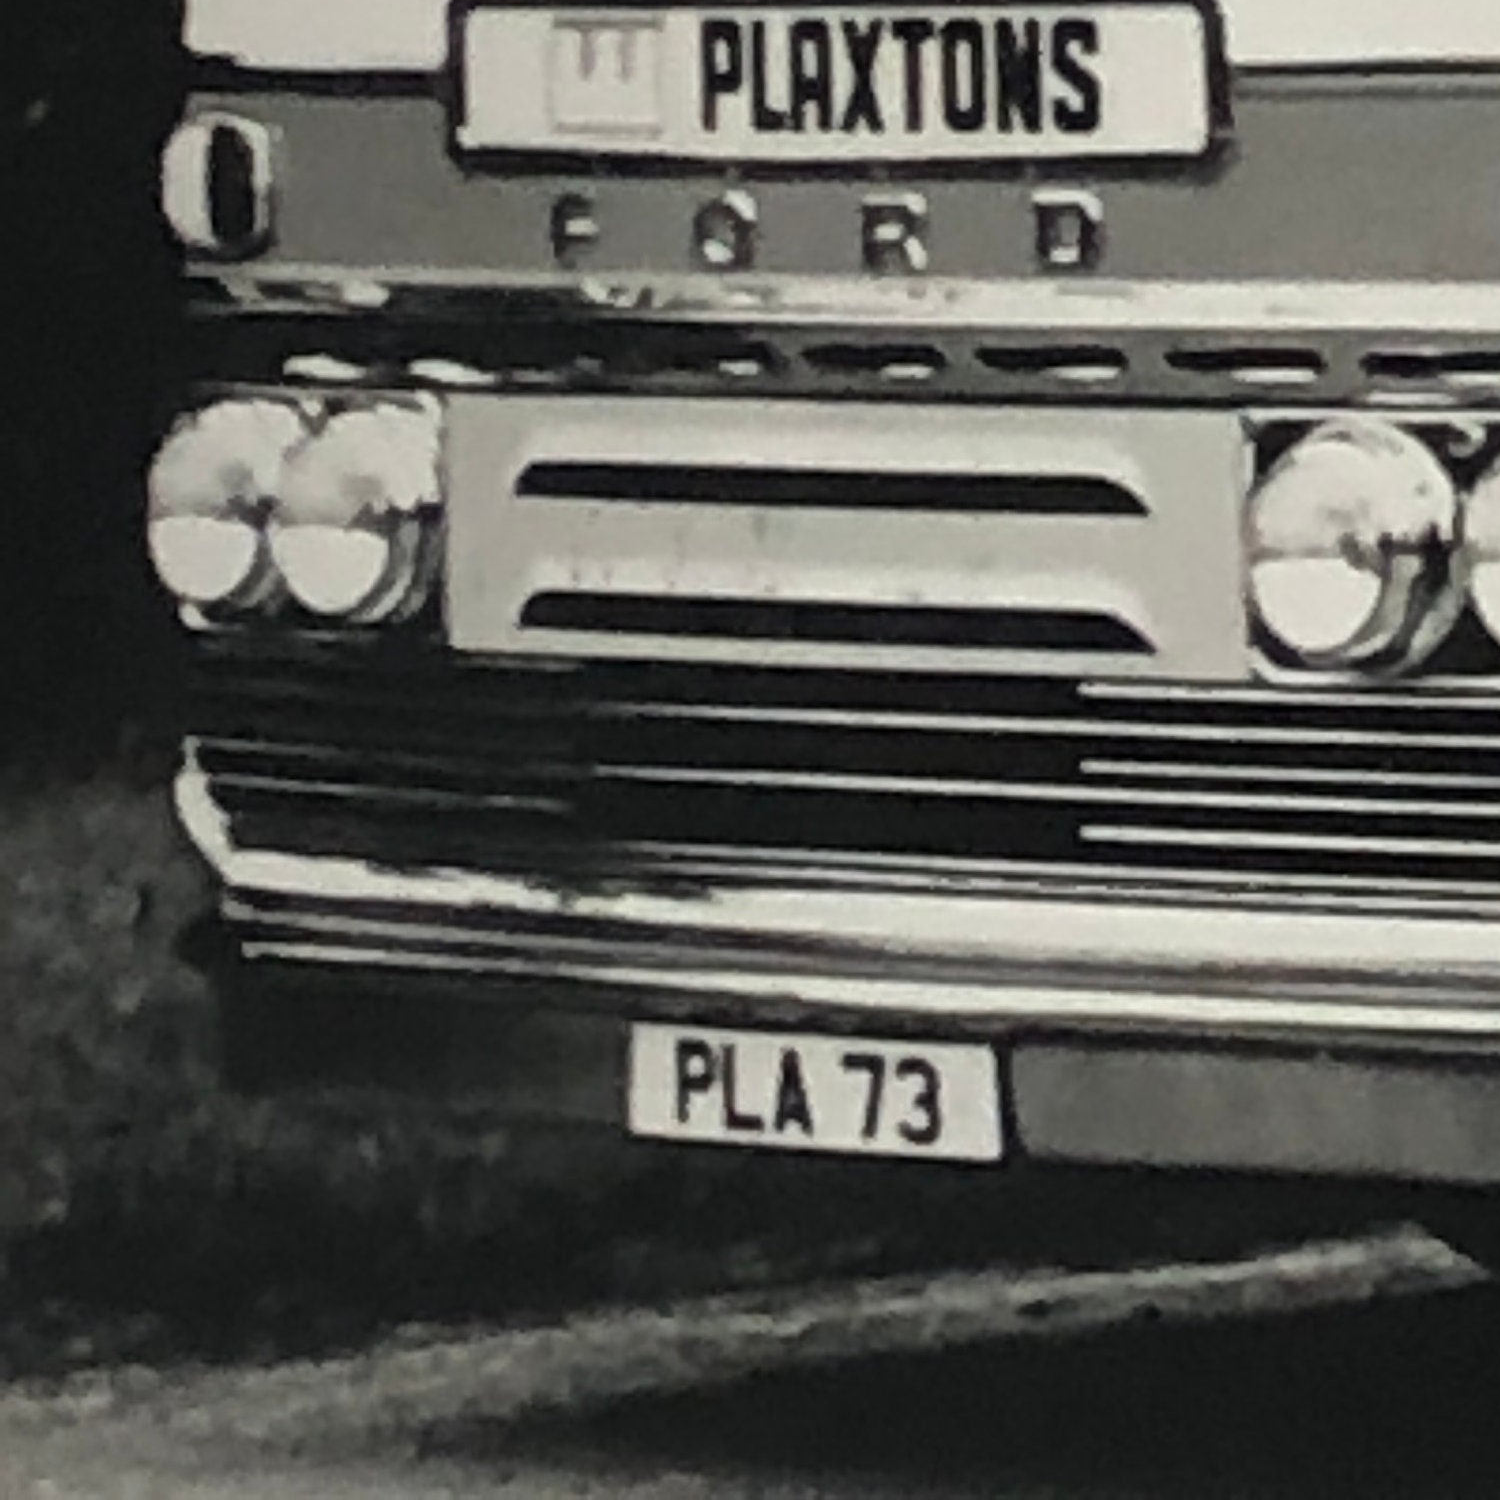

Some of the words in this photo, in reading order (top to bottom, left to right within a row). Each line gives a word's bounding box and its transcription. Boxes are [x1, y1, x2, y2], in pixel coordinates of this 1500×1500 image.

[701, 17, 1100, 133] PLAXTONS
[550, 190, 1102, 270] FORD
[675, 1039, 813, 1137] PLA
[842, 1053, 942, 1145] 73
